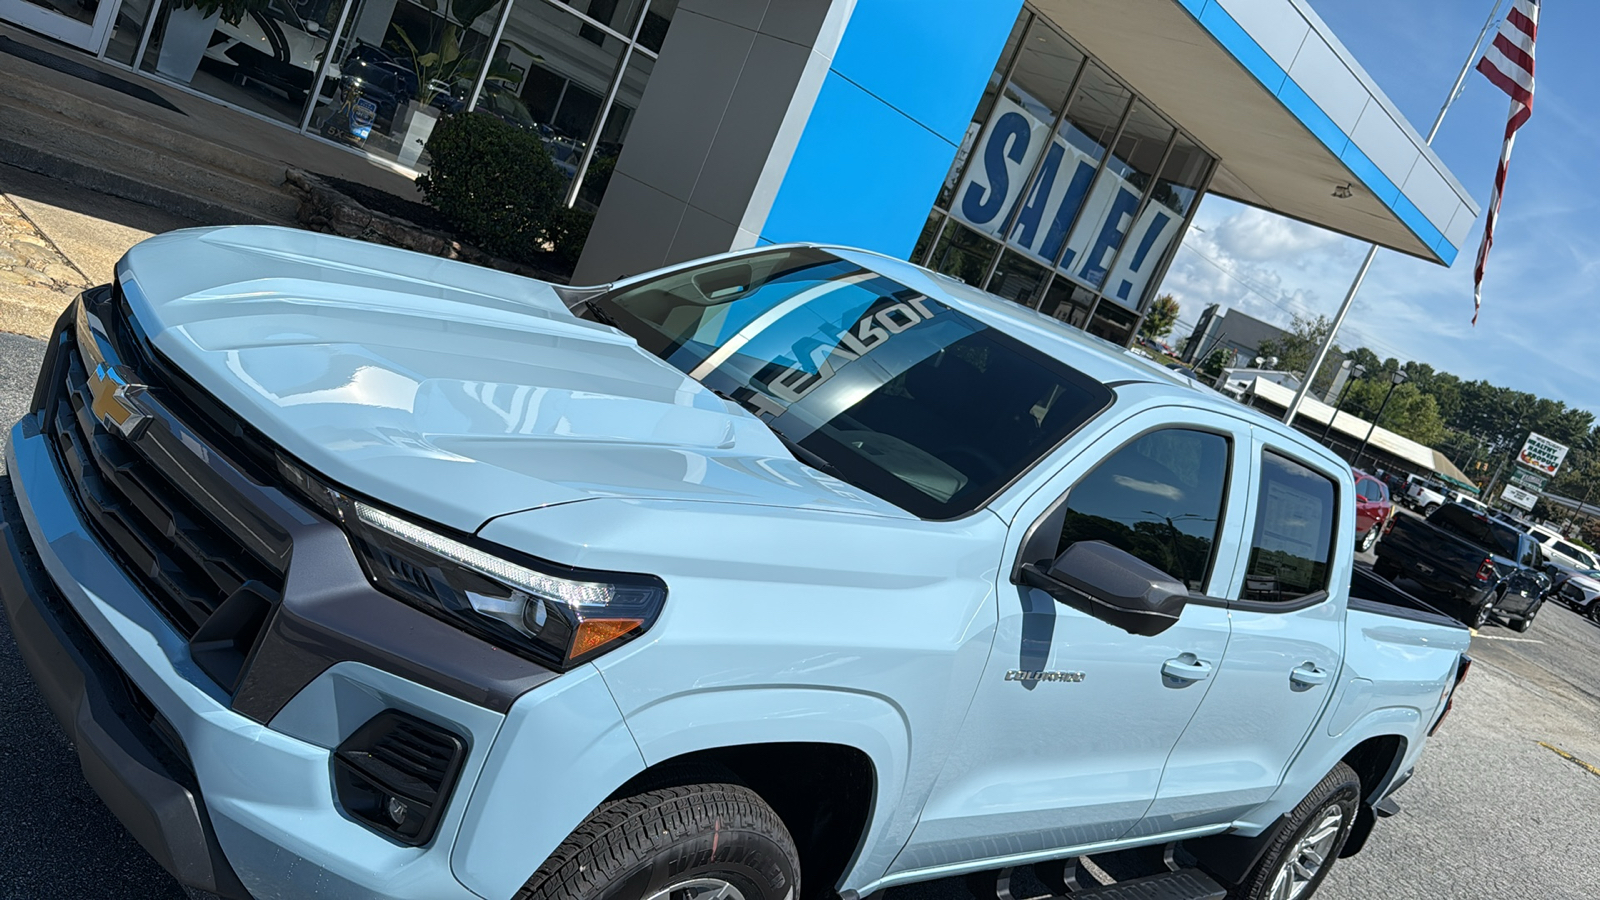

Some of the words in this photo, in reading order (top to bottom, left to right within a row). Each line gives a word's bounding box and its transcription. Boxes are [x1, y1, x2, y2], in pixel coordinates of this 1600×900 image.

[962, 112, 1171, 301] SALE!
[1528, 438, 1558, 454] HEALTHY
[1528, 445, 1558, 461] HARVEST
[1527, 451, 1559, 468] PRODUCE
[1004, 669, 1086, 682] COLORADO
